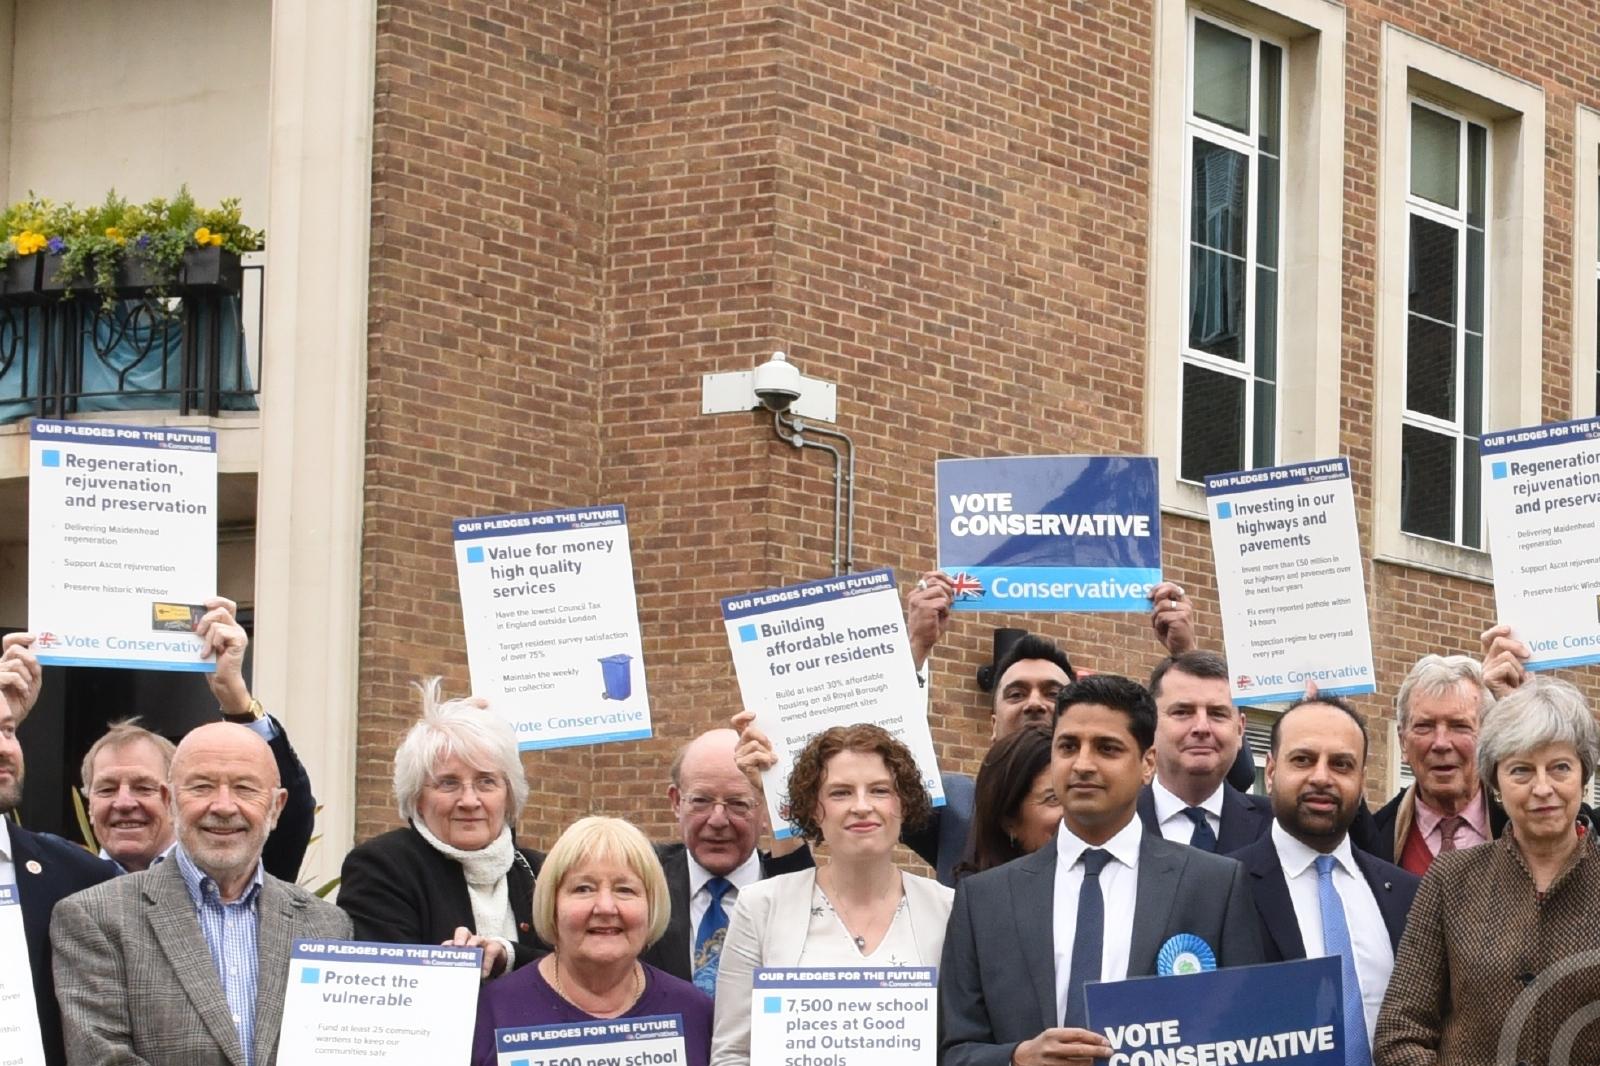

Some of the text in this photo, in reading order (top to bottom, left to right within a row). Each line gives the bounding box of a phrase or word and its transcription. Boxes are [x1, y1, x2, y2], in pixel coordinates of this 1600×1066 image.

[36, 423, 211, 445] OUR PLEDGES FOR THE FUTURE
[65, 453, 183, 476] Regeneration,
[65, 473, 171, 494] rejuvenation
[1513, 471, 1600, 497] rejuvenation
[64, 494, 207, 515] and preservation
[950, 493, 1012, 513] VOTE
[1234, 493, 1335, 516] Investing in our
[1515, 497, 1541, 515] and
[950, 514, 1150, 536] CONSERVATIVE
[1236, 510, 1327, 537] highways and
[487, 539, 614, 561] Value for money
[1239, 533, 1311, 557] pavements
[490, 558, 582, 582] high quality
[492, 581, 556, 599] services
[760, 616, 825, 638] Building
[766, 622, 899, 658] affordable homes
[1528, 639, 1559, 657] Vote
[769, 642, 895, 676] for our residents
[324, 970, 419, 989] Protect the
[758, 971, 931, 981] OUR PLEDGES FOR THE FUTURE
[322, 990, 413, 1007] vulnerable
[786, 998, 929, 1014] 7,500 new school
[786, 1016, 905, 1034] places at Good
[1104, 1019, 1181, 1050] VOTE
[785, 1034, 921, 1052] and Outstanding
[625, 1048, 678, 1066] school
